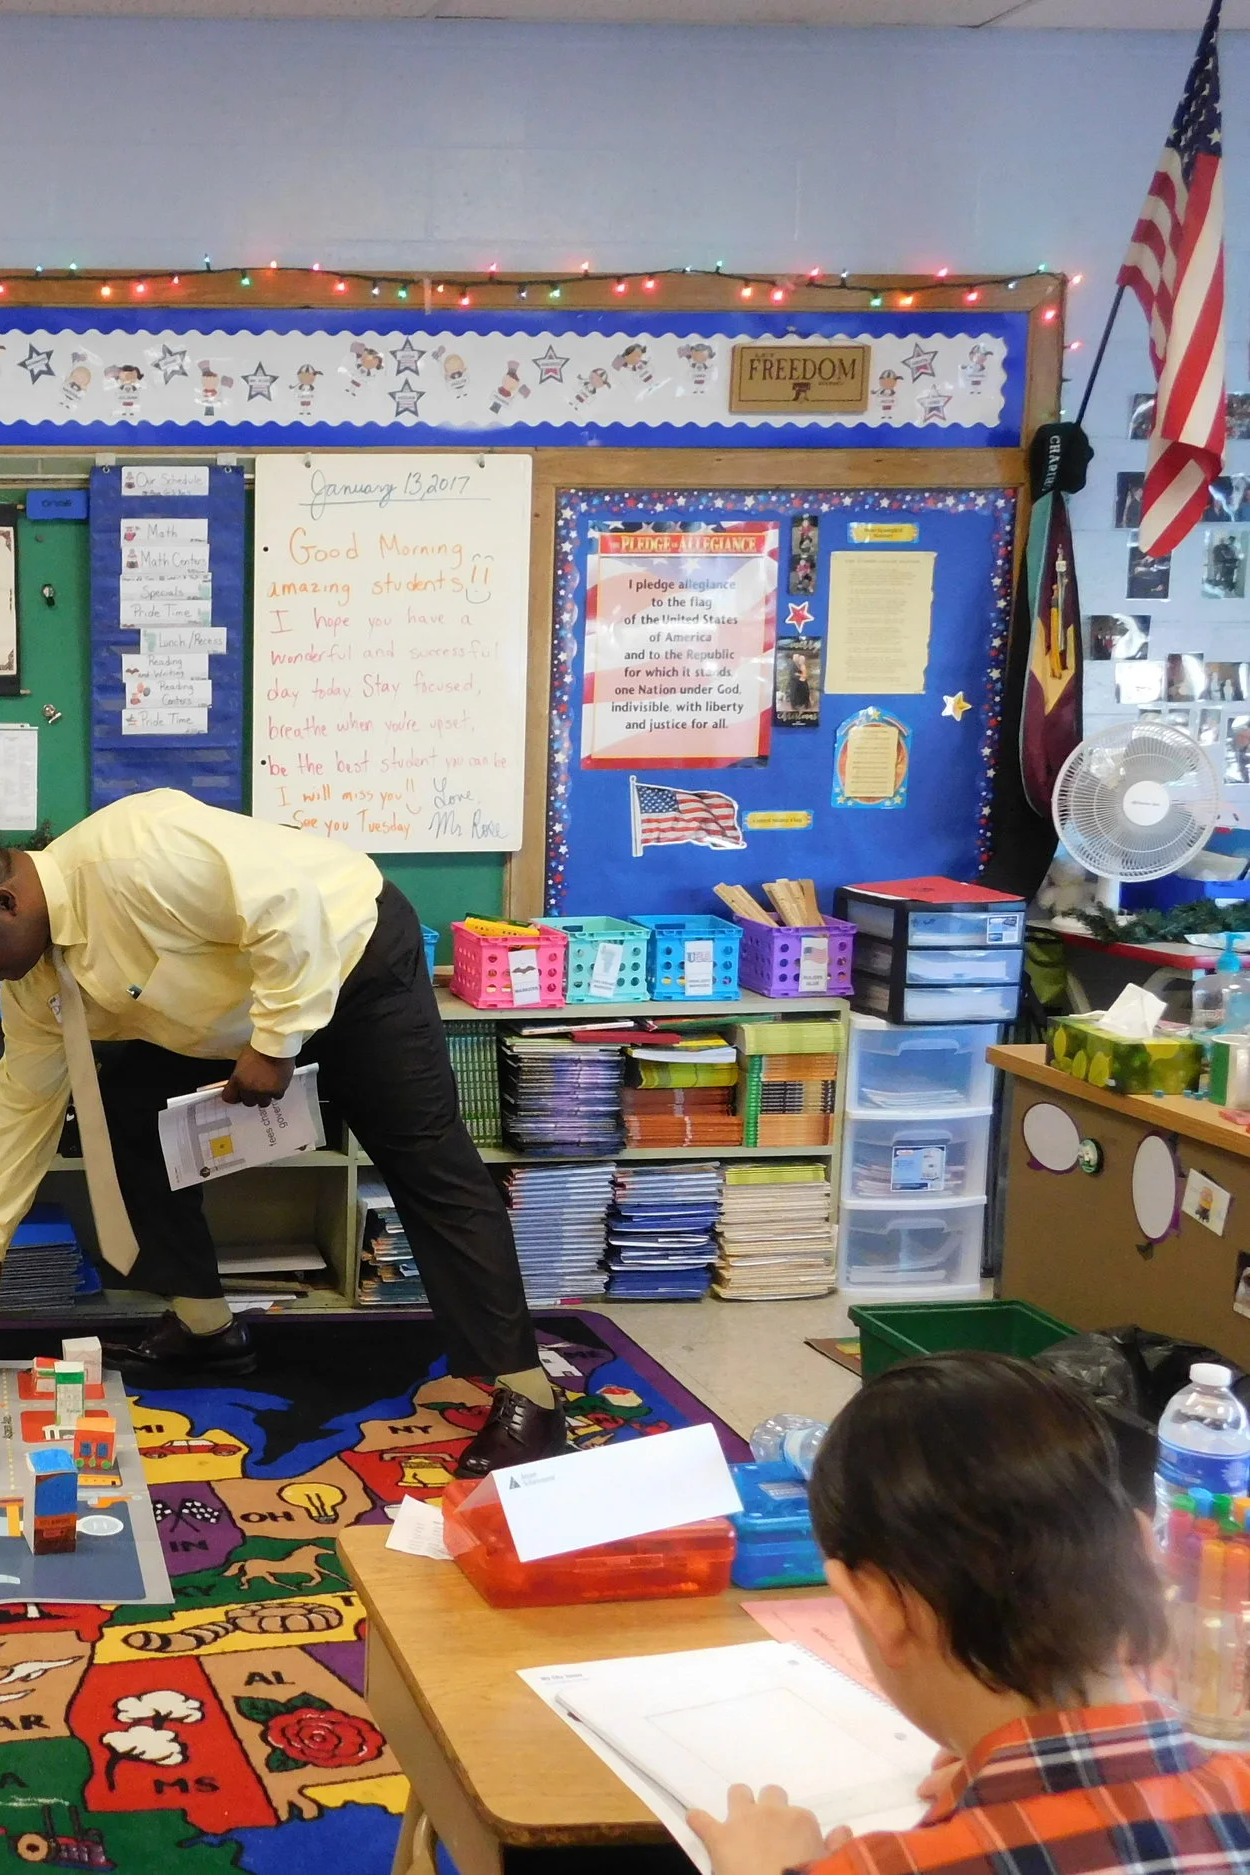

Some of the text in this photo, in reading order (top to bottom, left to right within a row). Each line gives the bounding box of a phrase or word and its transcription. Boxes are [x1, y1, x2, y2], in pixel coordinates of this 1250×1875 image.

[748, 356, 858, 381] FREEDOM
[310, 469, 397, 520] January
[147, 523, 178, 540] Math
[289, 527, 463, 570] Good Morning
[620, 536, 671, 553] PLEDGE
[678, 536, 757, 553] ALLEGIANCE
[140, 549, 169, 567] Math
[140, 584, 184, 600] Specials
[268, 581, 351, 607] amazing
[628, 578, 736, 593] I pledge allegiance
[130, 602, 192, 618] Pride Time
[651, 596, 712, 610] to the flag
[269, 606, 473, 641] I hope you have a
[623, 614, 738, 625] of the United States
[159, 631, 186, 648] Lunch
[649, 632, 712, 643] of America
[147, 654, 183, 670] Reading
[270, 642, 352, 666] wonderful
[362, 641, 395, 659] and
[624, 649, 735, 662] and to the Republic
[624, 667, 641, 678] for
[645, 667, 679, 678] which
[682, 667, 691, 678] it
[157, 680, 194, 696] Reading
[266, 677, 300, 708] day
[362, 673, 401, 699] Stay
[614, 686, 635, 695] one
[638, 684, 677, 695] Nation
[680, 684, 713, 695] under
[676, 702, 702, 712] with
[705, 702, 744, 714] liberty
[138, 710, 195, 727] Pride Time
[268, 715, 328, 741] breathe
[336, 711, 374, 732] when
[625, 719, 729, 732] and justice for all.
[268, 754, 288, 777] be
[297, 752, 324, 776] the
[334, 750, 370, 774] best
[380, 746, 438, 774] student
[277, 786, 292, 807] I
[302, 783, 331, 802] will
[341, 786, 374, 802] miss
[292, 808, 412, 840] See you Tuesday
[388, 1424, 433, 1435] NY
[239, 1511, 296, 1524] OH
[169, 1539, 210, 1553] IN
[244, 1669, 296, 1687] AL
[152, 1775, 220, 1794] MS
